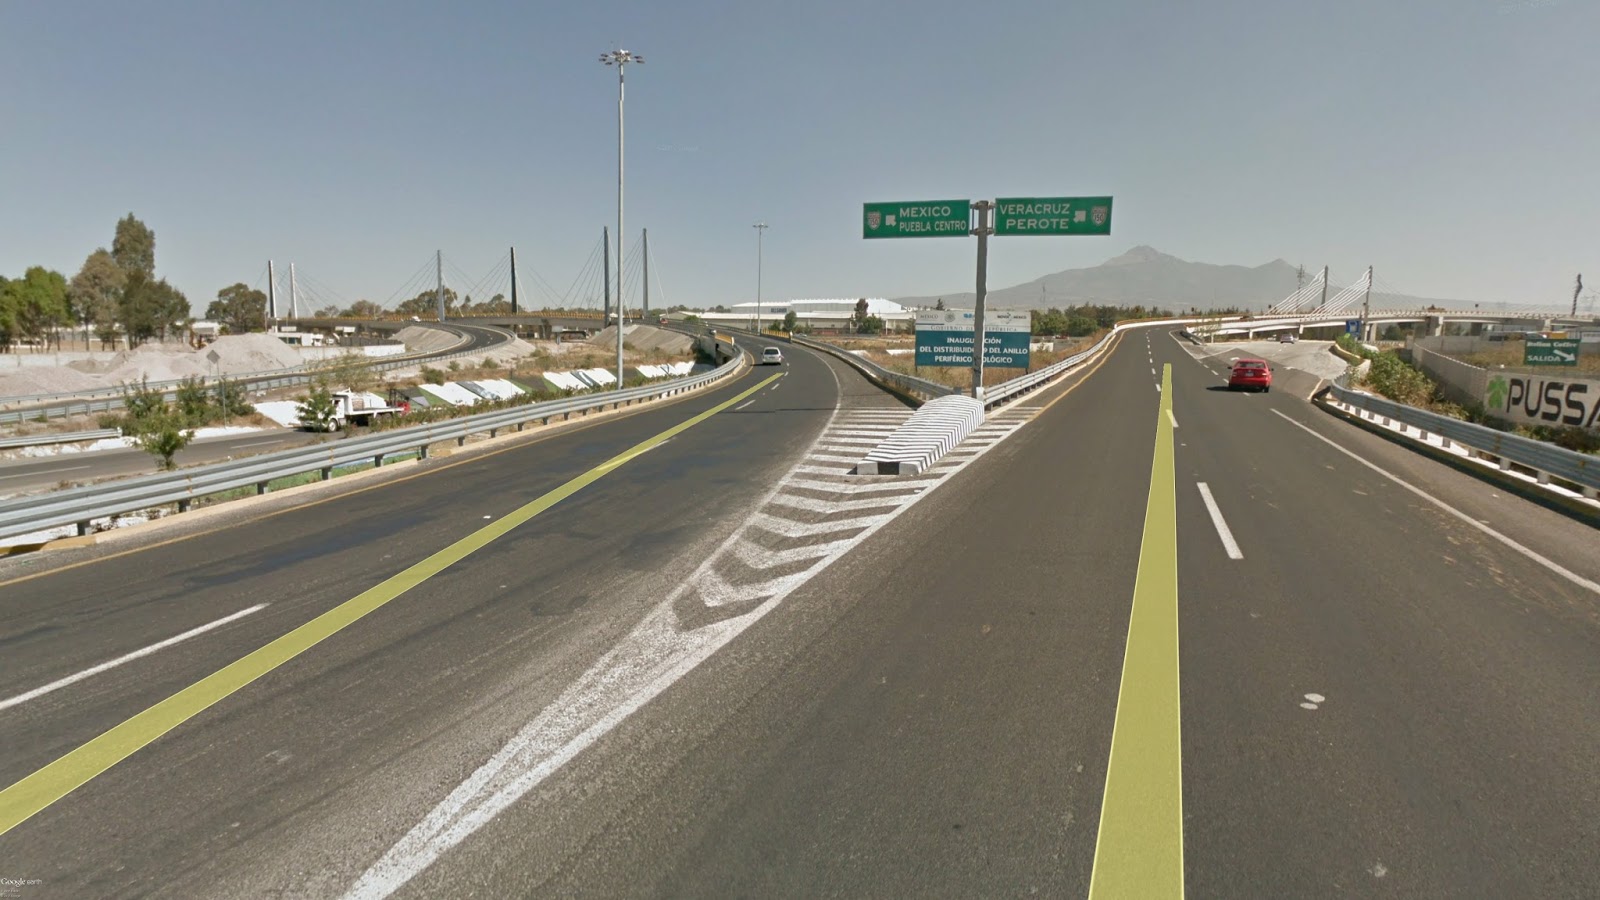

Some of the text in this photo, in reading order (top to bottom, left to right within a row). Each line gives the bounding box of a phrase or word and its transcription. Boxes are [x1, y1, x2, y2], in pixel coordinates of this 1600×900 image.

[900, 206, 951, 218] MEXICO
[1000, 203, 1071, 215] VERACRUZ
[900, 220, 967, 232] PUEBLA CENTRO
[1006, 218, 1070, 230] PEROTE
[934, 354, 1013, 364] PERIFÉRICO OLÓGICO
